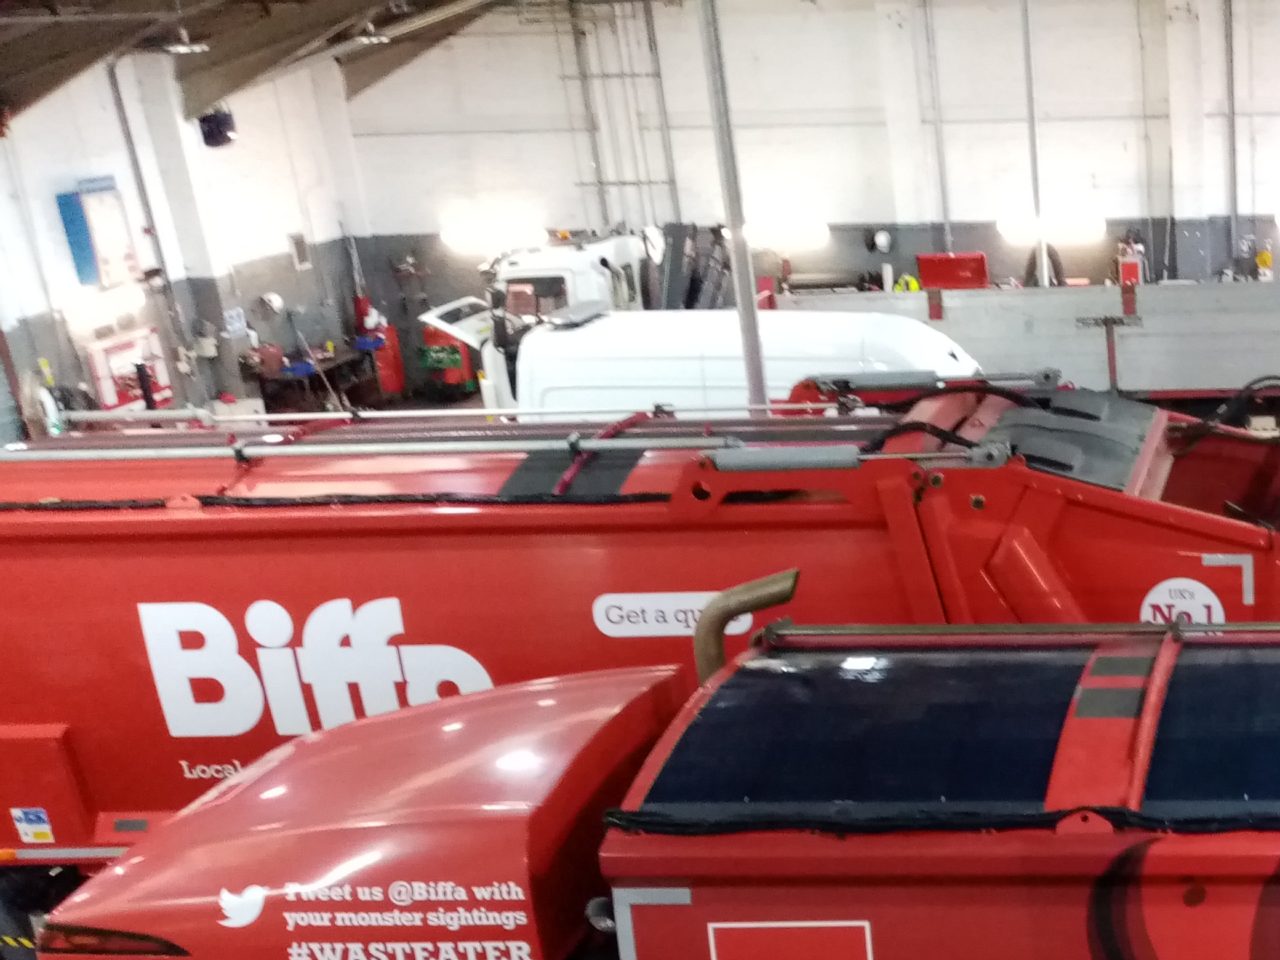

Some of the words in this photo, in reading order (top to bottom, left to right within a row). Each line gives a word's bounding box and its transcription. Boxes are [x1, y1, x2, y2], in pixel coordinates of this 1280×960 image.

[604, 605, 648, 625] Get
[654, 610, 669, 624] a
[356, 887, 385, 901] us
[388, 881, 469, 906] @Biffa
[472, 881, 526, 901] with
[283, 911, 332, 931] your
[334, 909, 424, 927] monster
[426, 907, 528, 930] sightings
